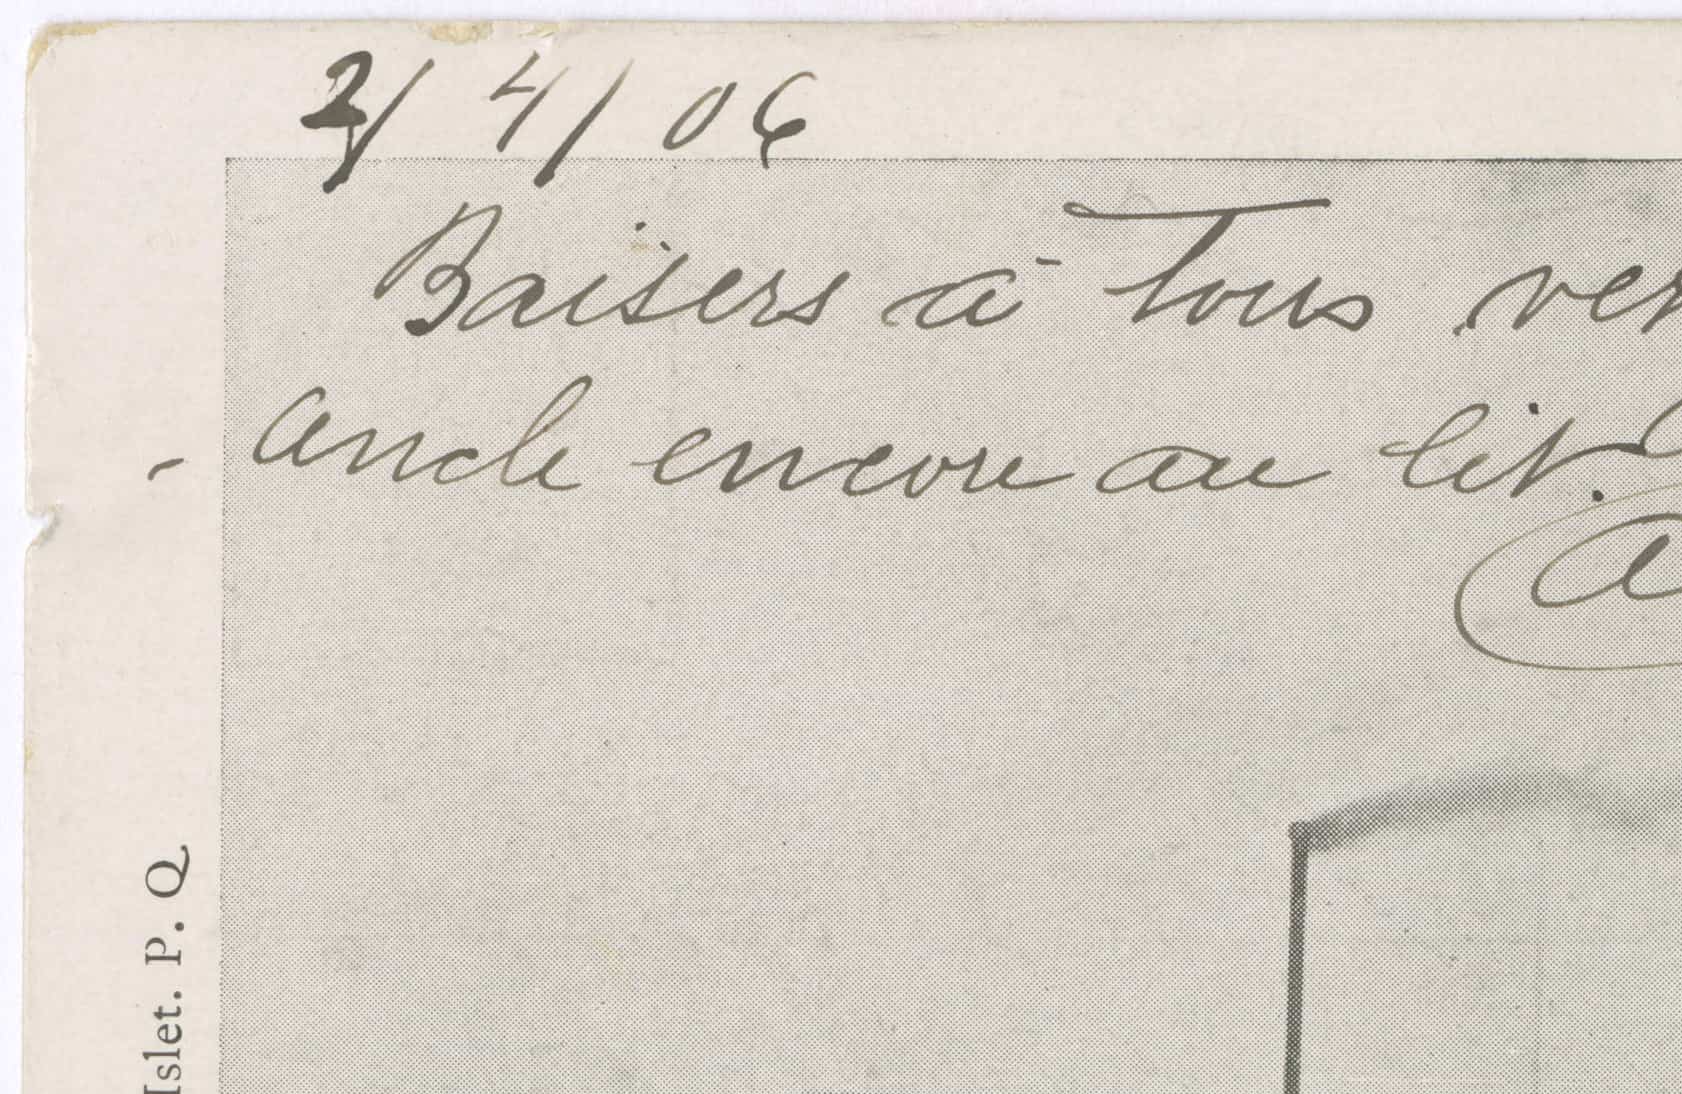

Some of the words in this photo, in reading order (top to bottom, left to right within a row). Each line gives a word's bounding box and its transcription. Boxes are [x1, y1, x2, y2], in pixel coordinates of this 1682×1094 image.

[374, 202, 850, 338] Baisers
[629, 426, 1076, 499] encore
[1095, 444, 1332, 494] au
[144, 921, 185, 965] P.
